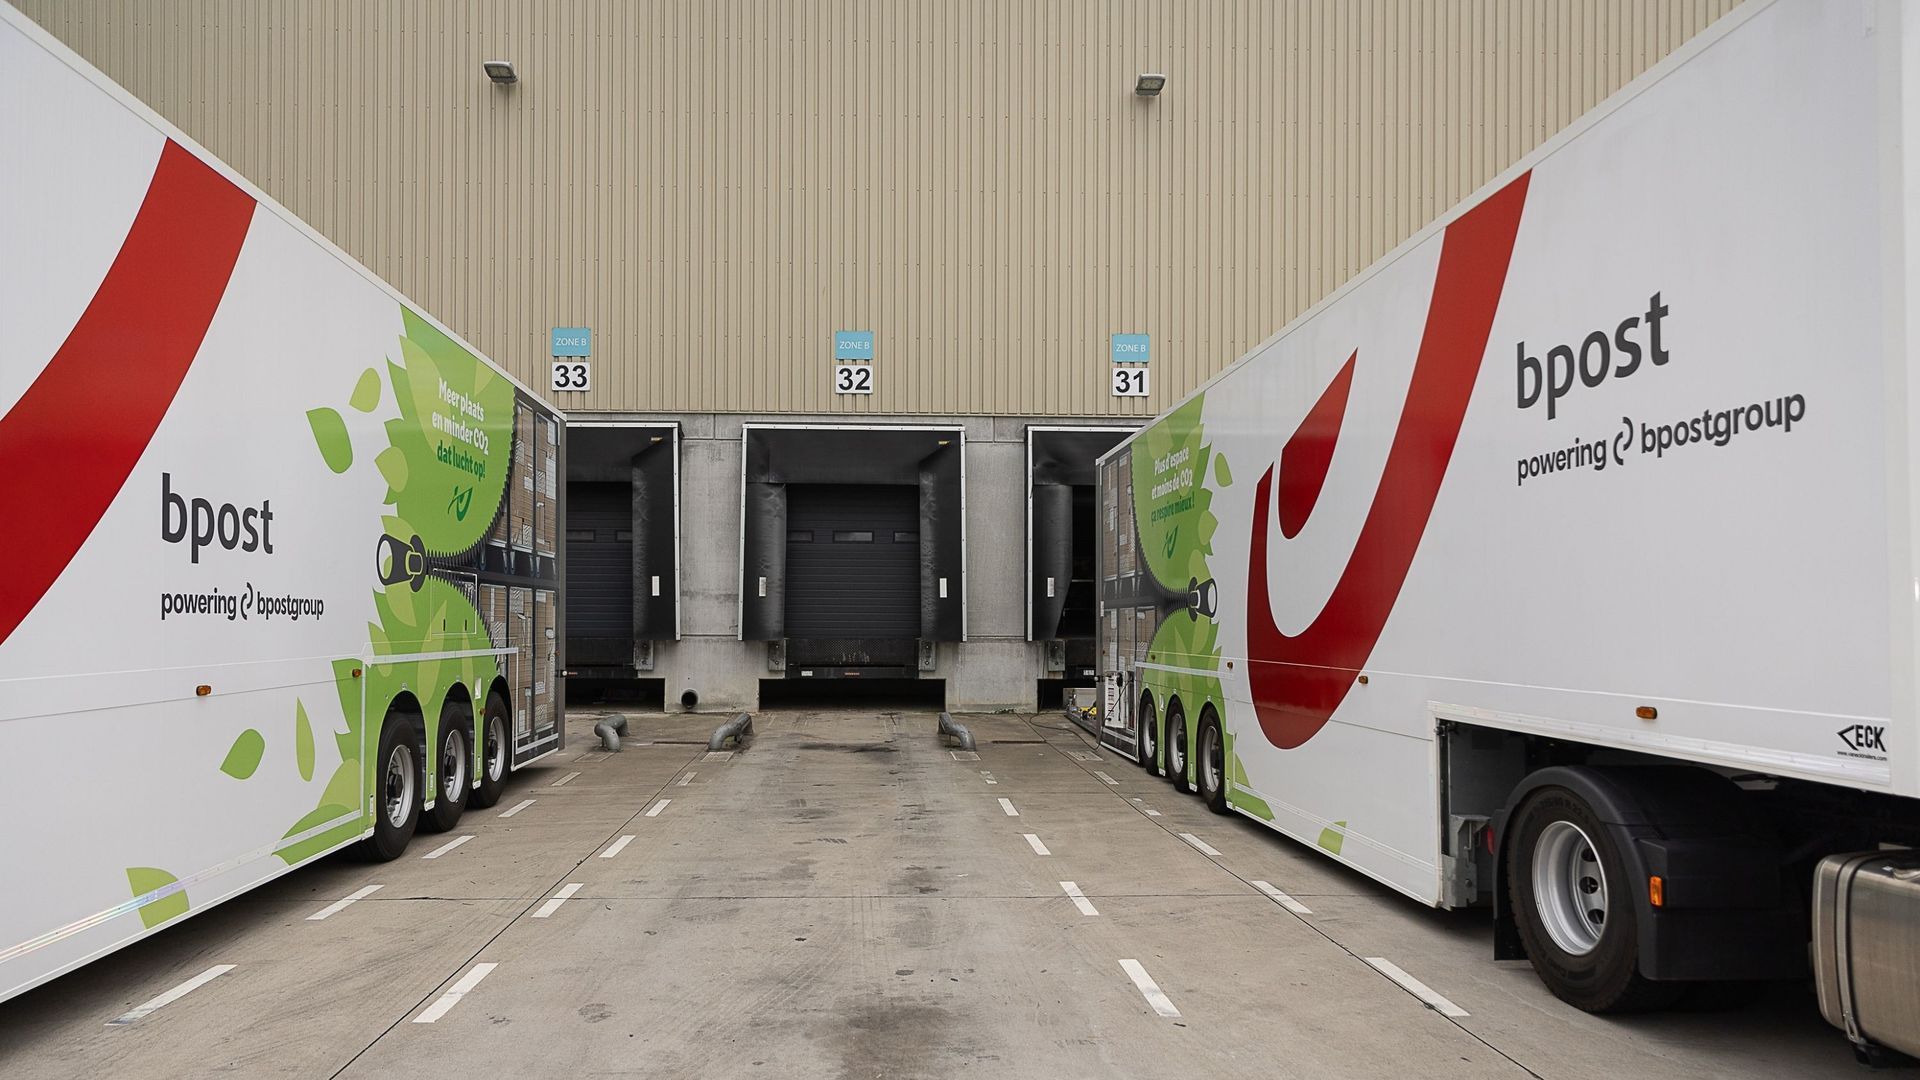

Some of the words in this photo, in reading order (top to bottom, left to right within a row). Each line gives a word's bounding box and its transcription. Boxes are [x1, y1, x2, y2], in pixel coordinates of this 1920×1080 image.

[555, 338, 580, 346] ZONE
[581, 338, 587, 346] B
[839, 341, 863, 349] ZONE
[864, 341, 870, 349] B
[1116, 344, 1138, 352] ZONE
[1140, 344, 1146, 352] B
[1516, 291, 1670, 421] bpost
[555, 364, 588, 388] 33
[838, 368, 871, 391] 32
[1115, 371, 1144, 394] 31
[439, 377, 459, 407] Meer
[460, 392, 484, 421] plaats
[432, 411, 443, 430] en
[443, 414, 473, 445] minder
[1517, 437, 1608, 487] powering
[1640, 393, 1806, 459] bpostgroup
[437, 440, 452, 465] dat
[452, 444, 473, 474] lucht
[474, 460, 485, 482] op!
[1154, 457, 1165, 477] Plus
[161, 471, 274, 565] bpost
[161, 587, 237, 621] powering
[257, 591, 325, 621] bpostgroup
